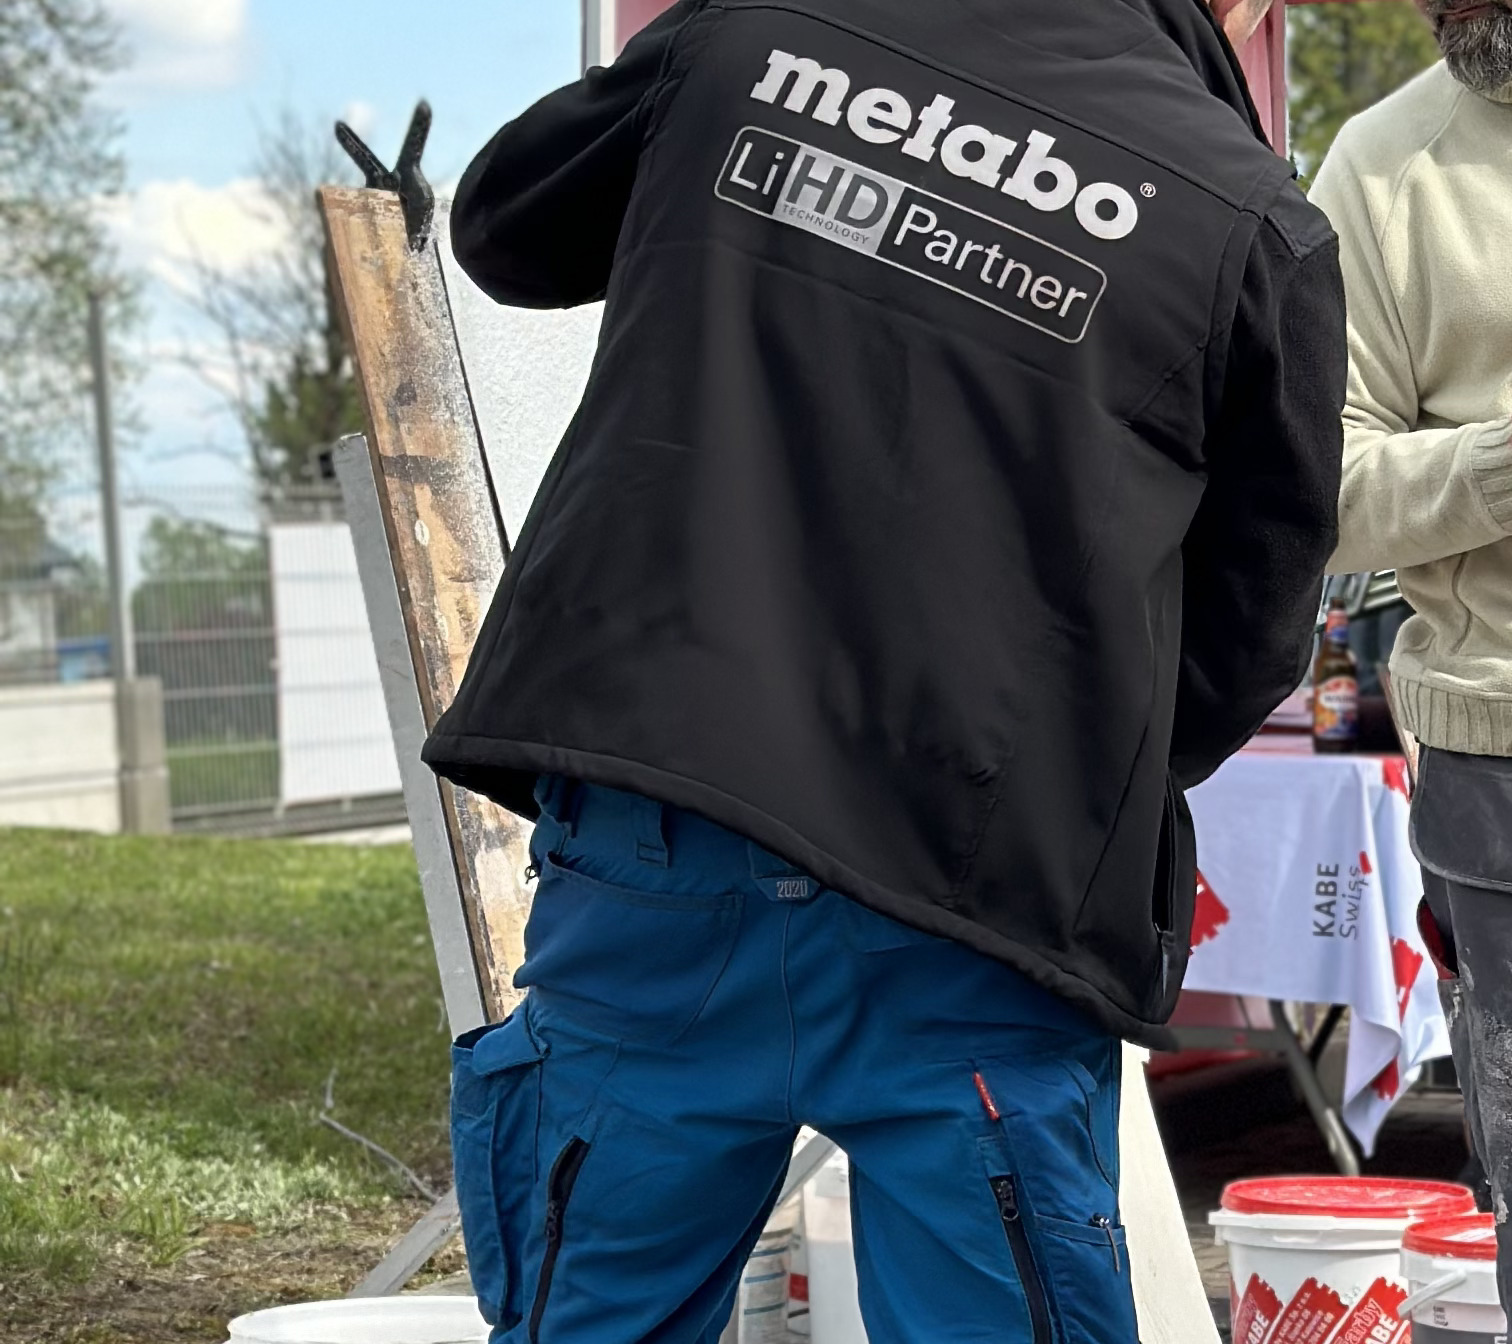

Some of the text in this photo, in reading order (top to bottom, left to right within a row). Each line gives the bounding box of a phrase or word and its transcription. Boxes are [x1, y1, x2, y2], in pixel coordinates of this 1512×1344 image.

[750, 48, 1139, 241] metabo
[781, 203, 871, 245] TECHNOLOGY
[893, 203, 1088, 319] Partner
[776, 879, 808, 898] 2020
[1312, 862, 1339, 938] KABE
[1338, 863, 1363, 942] Swiss
